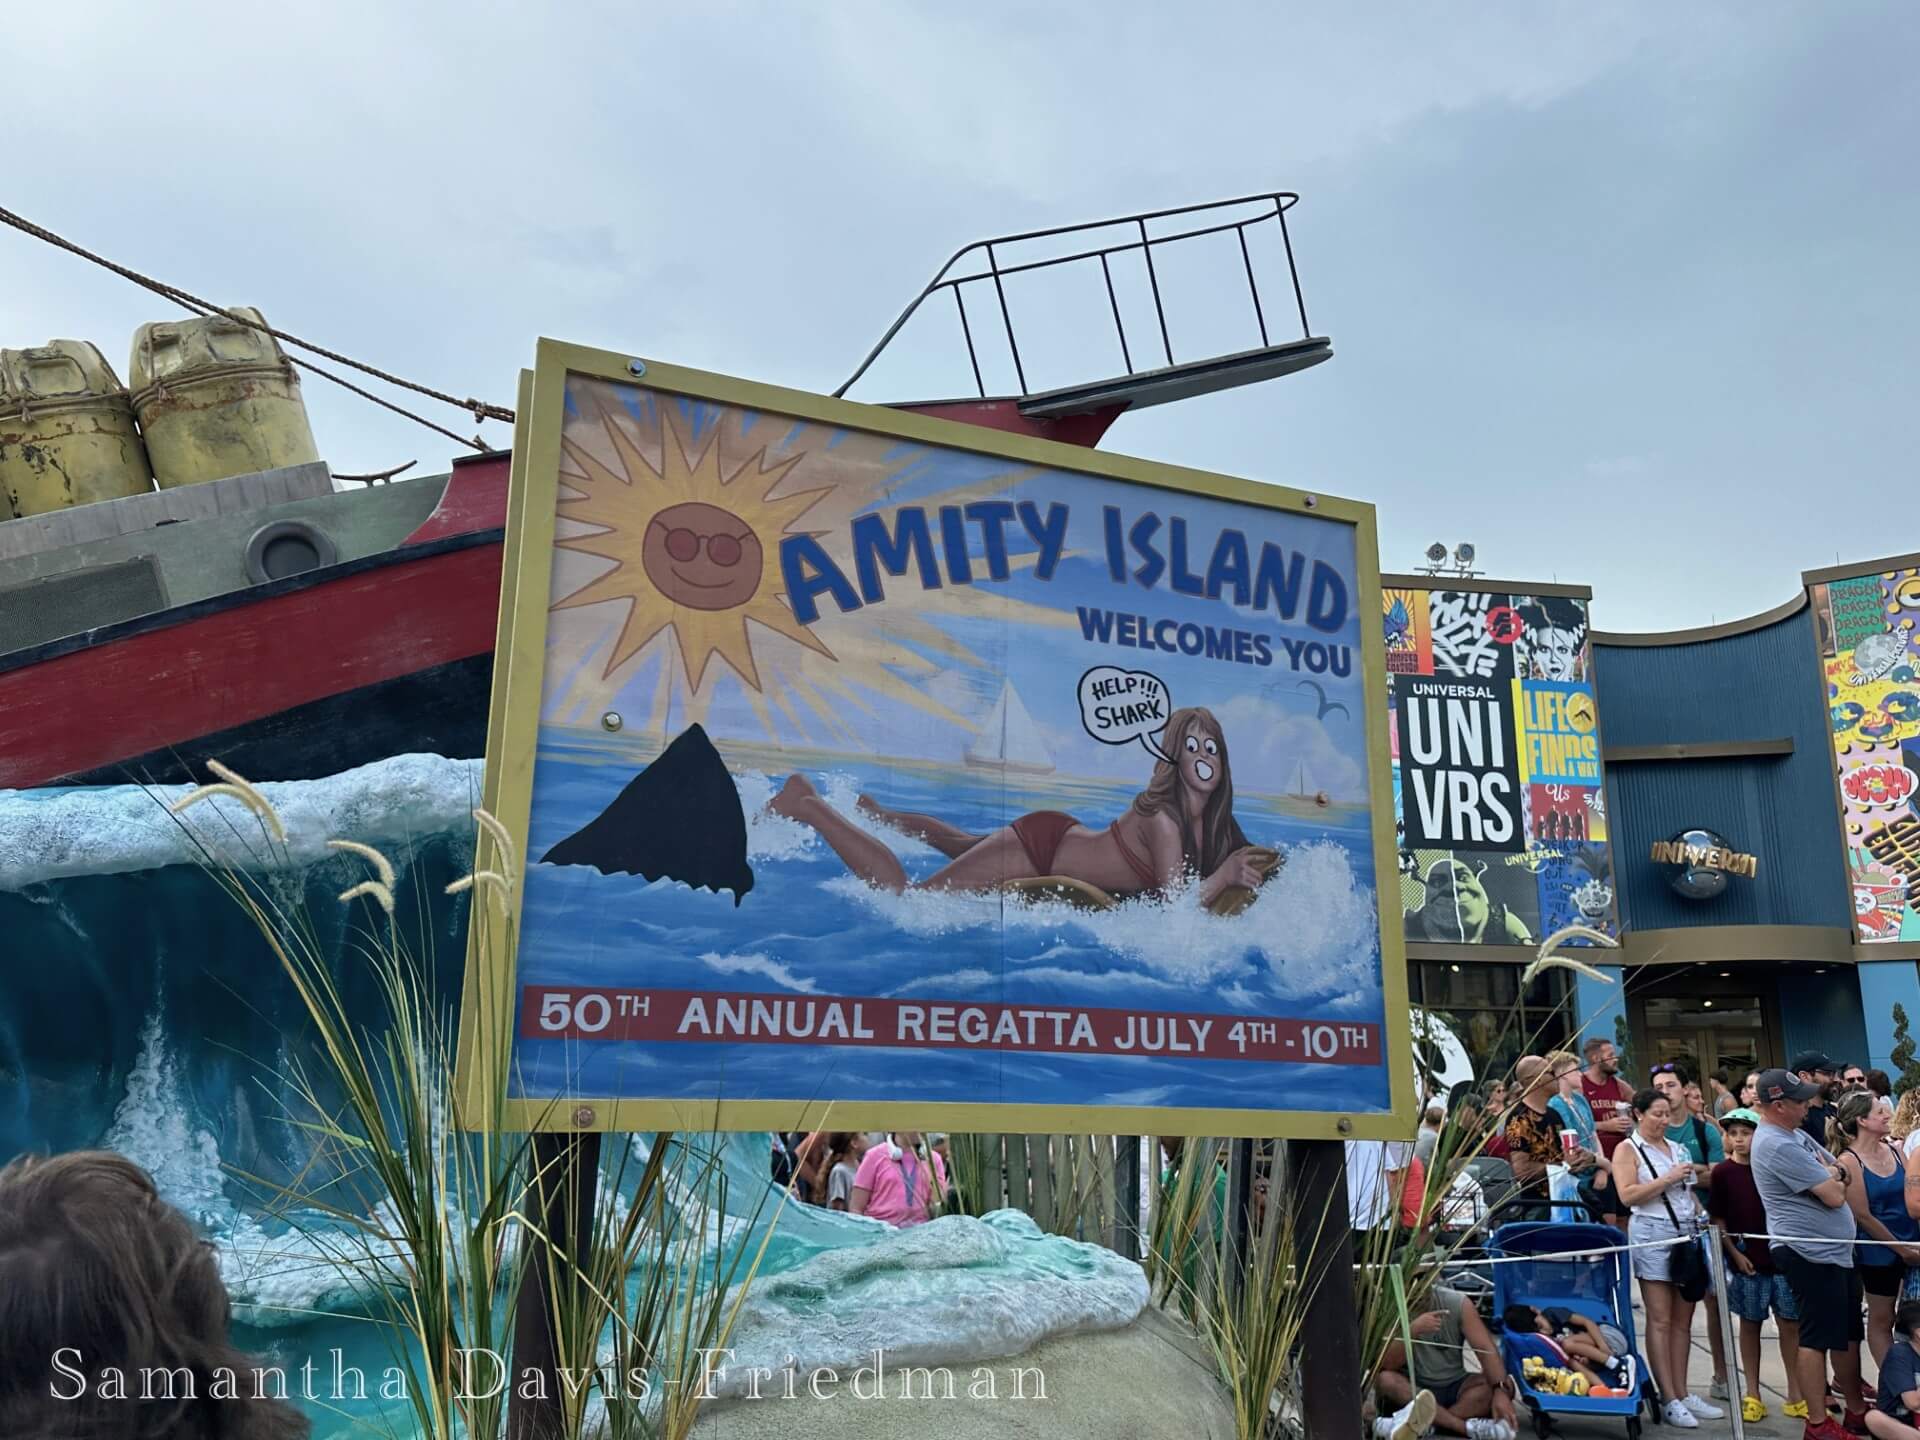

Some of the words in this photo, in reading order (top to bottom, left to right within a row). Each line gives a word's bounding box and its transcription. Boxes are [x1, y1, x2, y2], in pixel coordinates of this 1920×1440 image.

[779, 501, 1070, 626] AMITY
[1103, 505, 1349, 634] ISLAND
[1077, 606, 1273, 667] WELCOMES
[1279, 638, 1352, 678] YOU
[1091, 677, 1159, 701] HELP!!!
[1094, 699, 1165, 729] SHARK
[1412, 683, 1496, 699] UNIVERSAL
[1523, 690, 1570, 731] LIFE
[1407, 697, 1505, 767] UNI
[1412, 769, 1514, 843] VRS
[1504, 848, 1564, 867] UNIVERSAL
[539, 993, 650, 1033] 50TH
[676, 998, 875, 1039] ANNUAL
[897, 1005, 1098, 1048] REGATTA
[1114, 1016, 1214, 1052] JULY
[1227, 1020, 1277, 1054] 4TH
